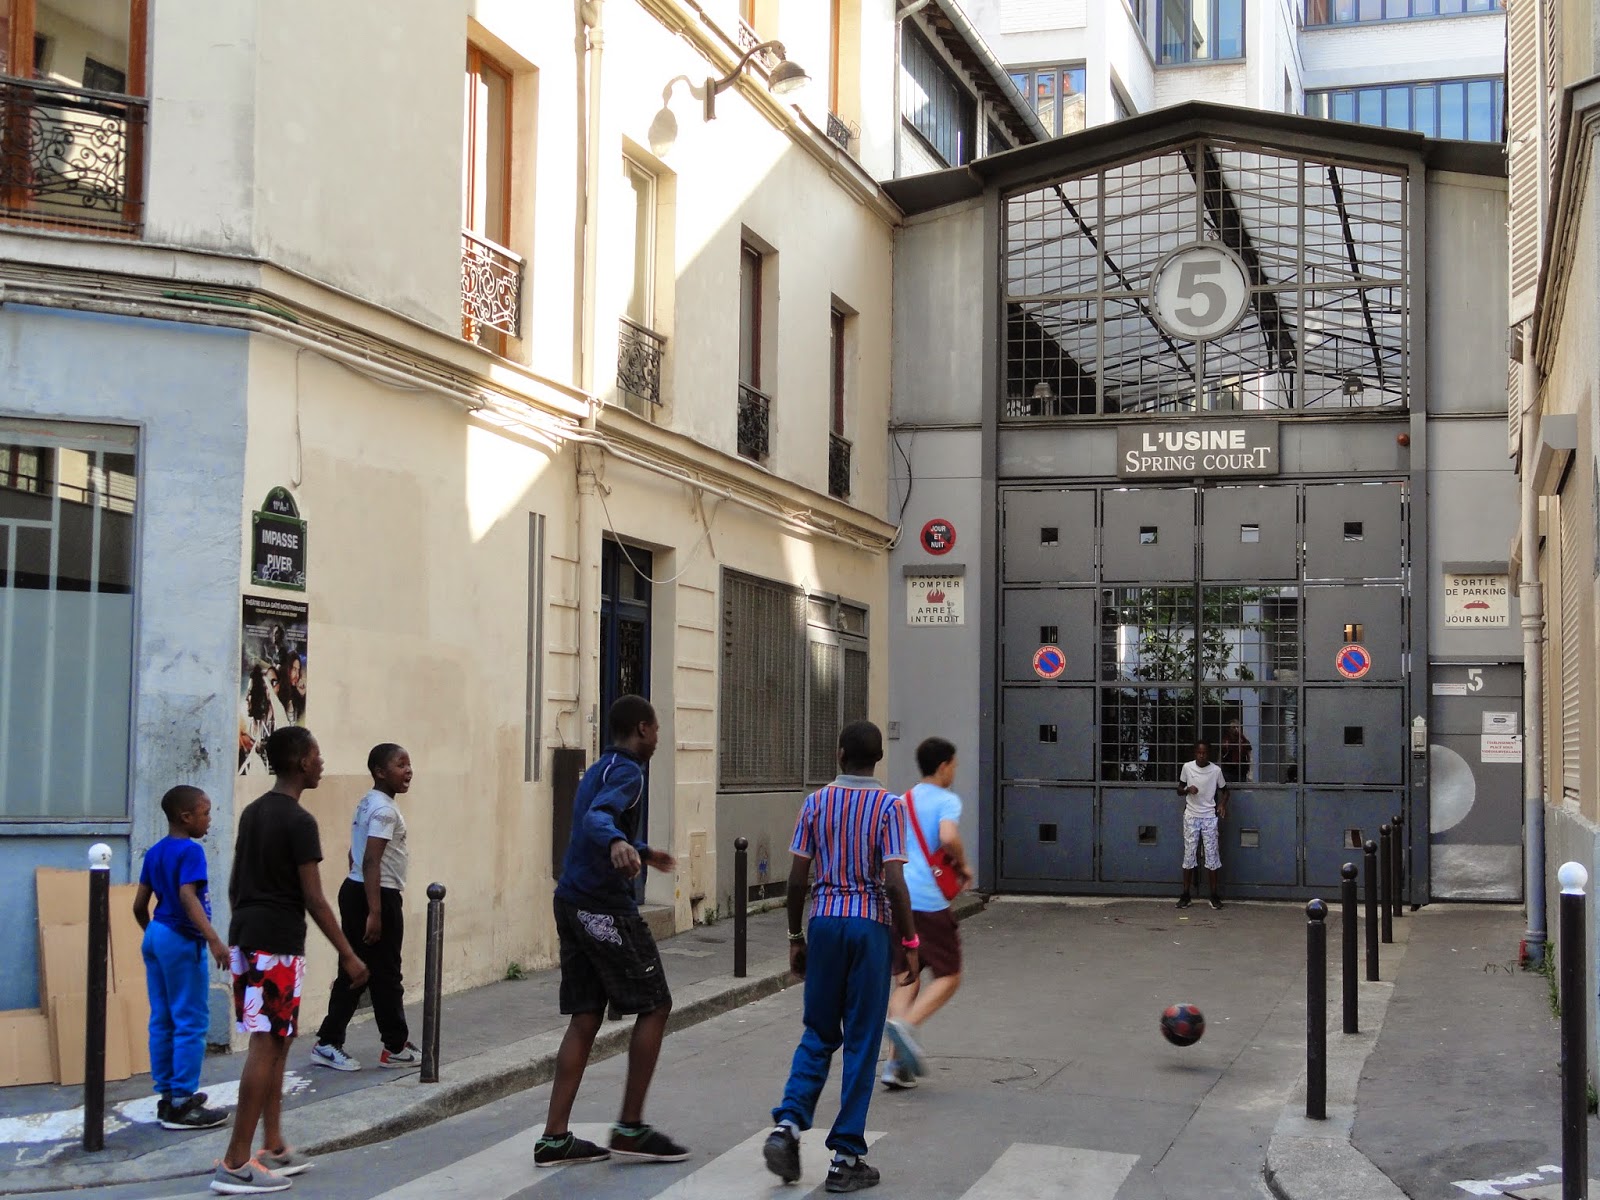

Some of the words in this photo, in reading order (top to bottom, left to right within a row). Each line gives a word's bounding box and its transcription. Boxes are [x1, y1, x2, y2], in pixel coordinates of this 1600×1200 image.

[1174, 260, 1227, 327] 5
[1142, 430, 1246, 451] L'USINE
[1125, 451, 1196, 472] SPRING
[1203, 447, 1271, 470] COURT
[262, 529, 299, 549] IMPASSE
[267, 553, 293, 571] PIVER
[1453, 578, 1496, 586] SORTIE
[1445, 588, 1459, 596] DE
[1463, 588, 1506, 596] PARKING
[911, 615, 960, 623] INTERDIT
[1446, 615, 1472, 623] JOUR
[1474, 615, 1480, 623] &
[1482, 615, 1506, 623] NUIT
[1467, 668, 1484, 692] 5
